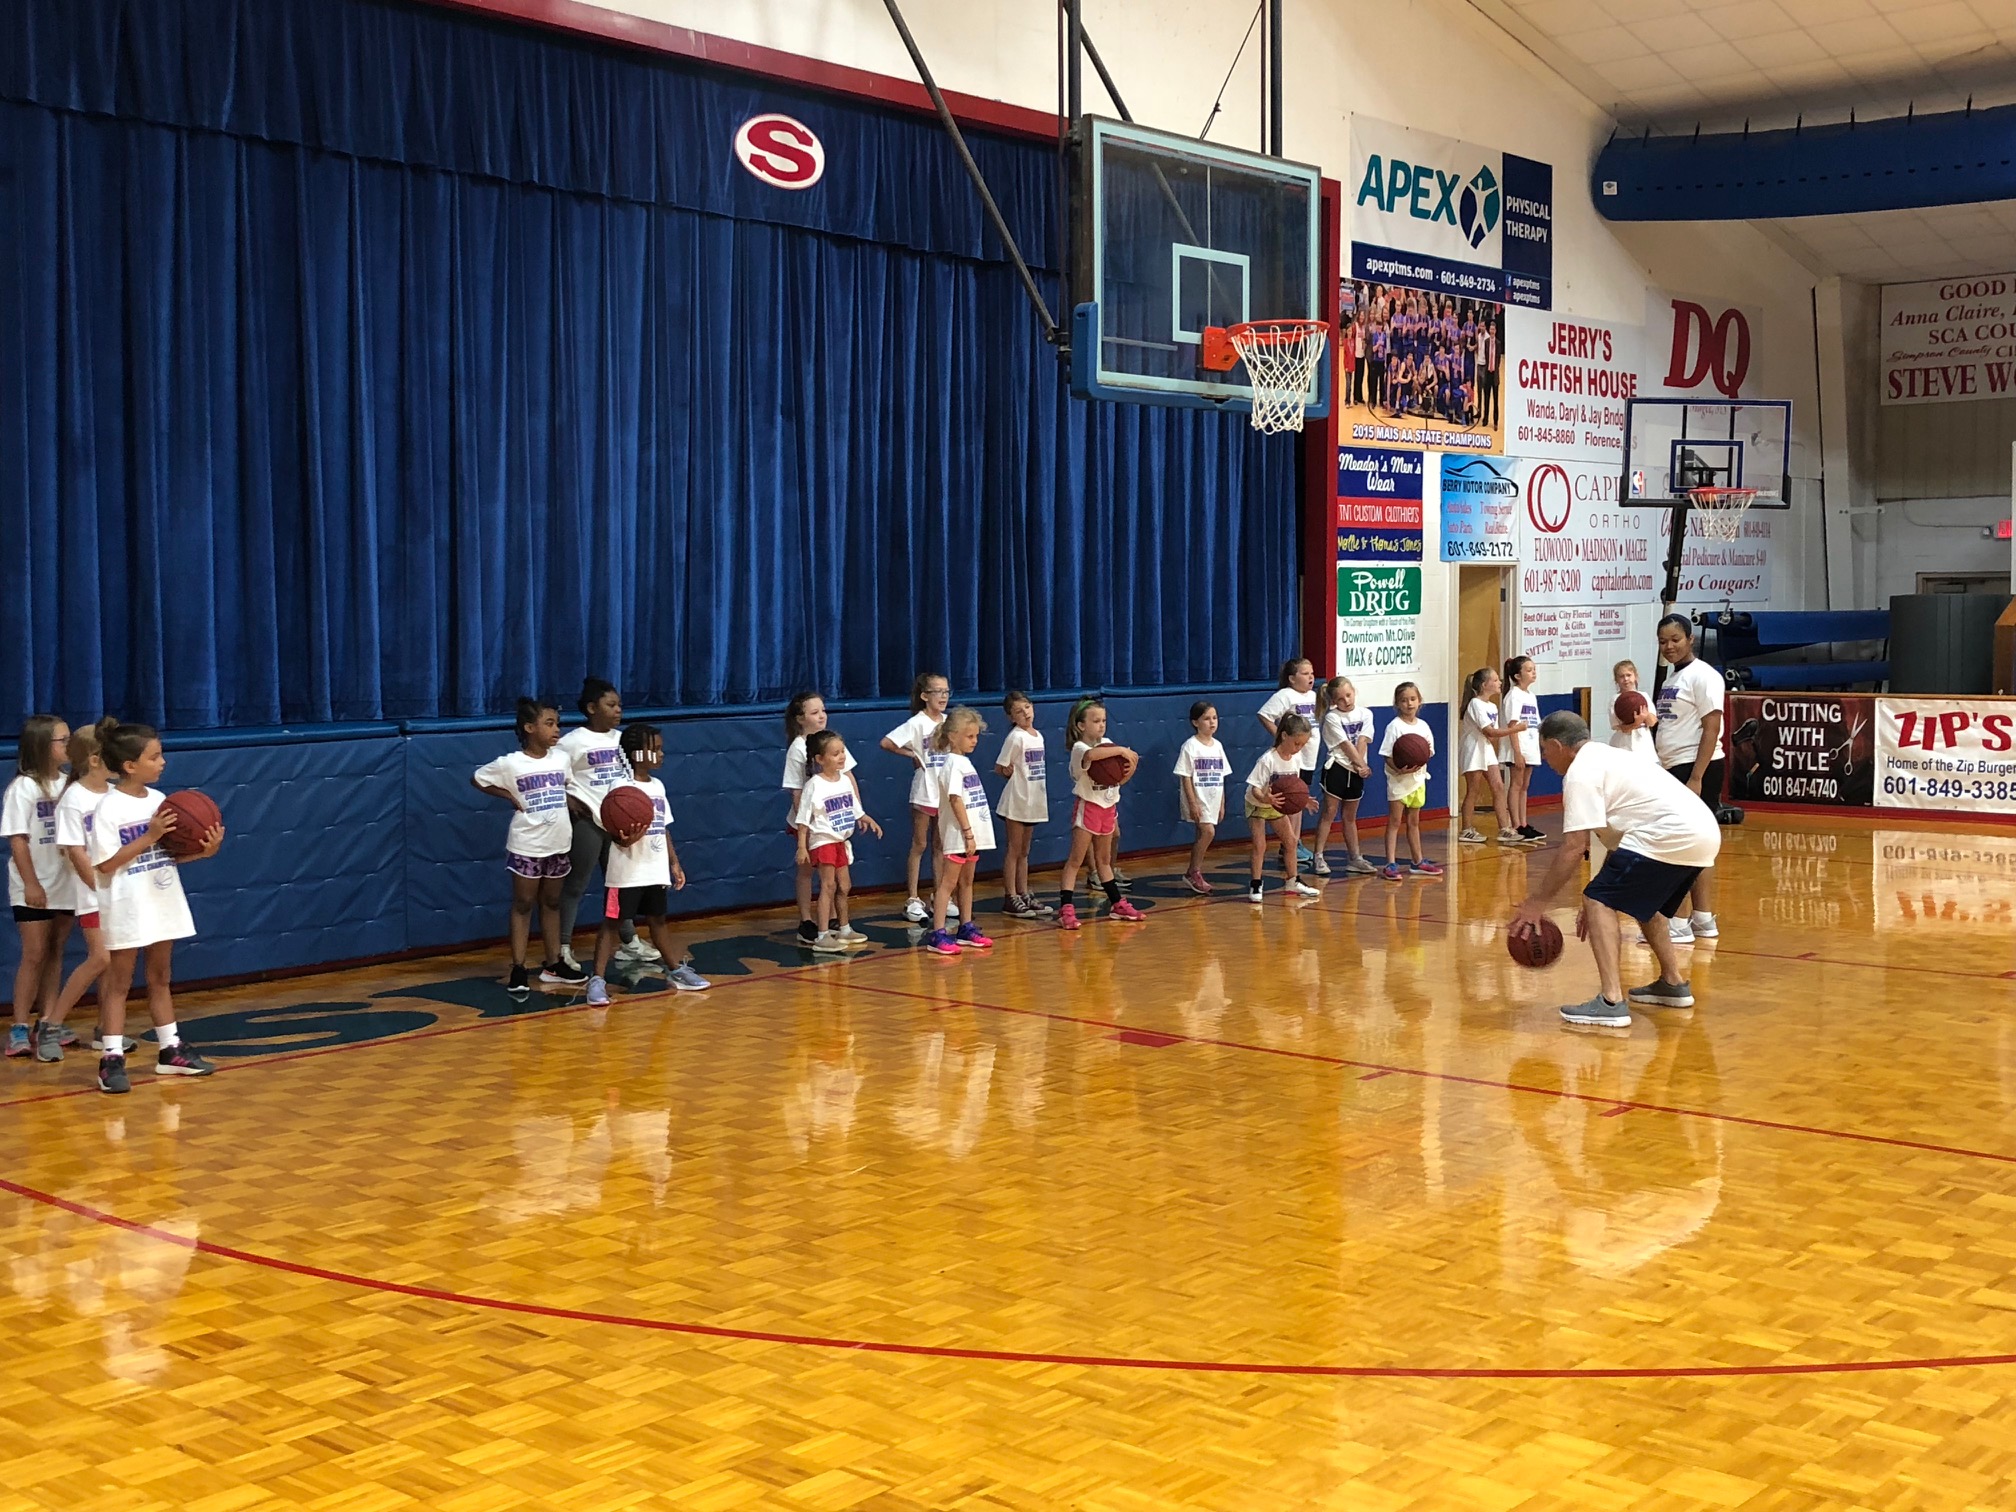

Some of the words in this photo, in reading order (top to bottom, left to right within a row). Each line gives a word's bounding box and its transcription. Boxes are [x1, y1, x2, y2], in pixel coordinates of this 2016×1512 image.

[747, 120, 816, 182] S
[1357, 154, 1460, 225] APEX
[1506, 196, 1551, 220] PHYSICAL
[1506, 220, 1548, 243] THERAPY
[1366, 257, 1433, 281] apexptms.com
[1440, 271, 1496, 293] 601-849-2734
[1939, 280, 2006, 301] GOOD
[1890, 310, 1939, 327] Anna
[1945, 303, 2005, 322] Claire,
[1547, 322, 1612, 362] JERRY'S
[1928, 327, 1968, 345] SCA
[1663, 299, 1750, 400] DQ
[1518, 359, 1582, 395] CATFISH
[1588, 368, 1638, 400] HOUSE
[1888, 364, 1978, 400] STEVE
[1984, 361, 2016, 393] W
[1527, 398, 1557, 423] Wanda,
[1559, 402, 1579, 427] Daryl
[1581, 404, 1587, 422] &
[1588, 405, 1602, 429] Jay
[1604, 406, 1624, 431] Bridg
[1352, 424, 1374, 439] 2015
[1376, 426, 1399, 441] MAIS
[1400, 428, 1413, 442] AA
[1415, 429, 1442, 444] STATE
[1443, 432, 1492, 448] CHAMPIONS
[1518, 425, 1575, 445] 601-845-8860
[1338, 453, 1388, 472] Meador's
[1391, 456, 1421, 474] Men's
[1367, 471, 1395, 492] Wear
[1463, 481, 1484, 493] MOTOR
[1484, 482, 1511, 494] COMPANY
[1339, 504, 1352, 521] TNT
[1353, 505, 1382, 522] CUSTOM
[1590, 513, 1640, 529] ORTHO
[1447, 541, 1513, 557] 601-849-2172
[1534, 538, 1573, 562] FLOWOOD
[1582, 538, 1618, 562] MADISON
[1624, 539, 1648, 562] MAGEE
[1351, 568, 1406, 591] Powell
[1524, 568, 1581, 593] 601-987-8200
[1591, 566, 1653, 600] capitalortho.com
[1698, 574, 1761, 596] Cougars!
[1349, 590, 1410, 616] DRUG
[1572, 609, 1592, 619] Florist
[1599, 609, 1620, 619] Hill's
[1523, 612, 1535, 622] Best
[1543, 612, 1557, 622] Luck
[1571, 621, 1586, 630] Gifts
[1342, 630, 1384, 643] Downtown
[1523, 627, 1534, 636] This
[1535, 627, 1547, 636] Year
[1346, 647, 1366, 667] MAX
[1376, 645, 1413, 666] COOPER
[1761, 698, 1842, 723] CUTTING
[1778, 726, 1825, 747] WITH
[1894, 711, 2013, 752] ZIP'S
[1772, 746, 1830, 772] STYLE
[1887, 756, 1918, 770] Home
[1921, 758, 1933, 771] of
[1935, 759, 1953, 772] the
[1956, 759, 1974, 776] Zip
[1978, 760, 2016, 777] Burger
[1763, 776, 1782, 796] 601
[1785, 776, 1838, 798] 847-4740
